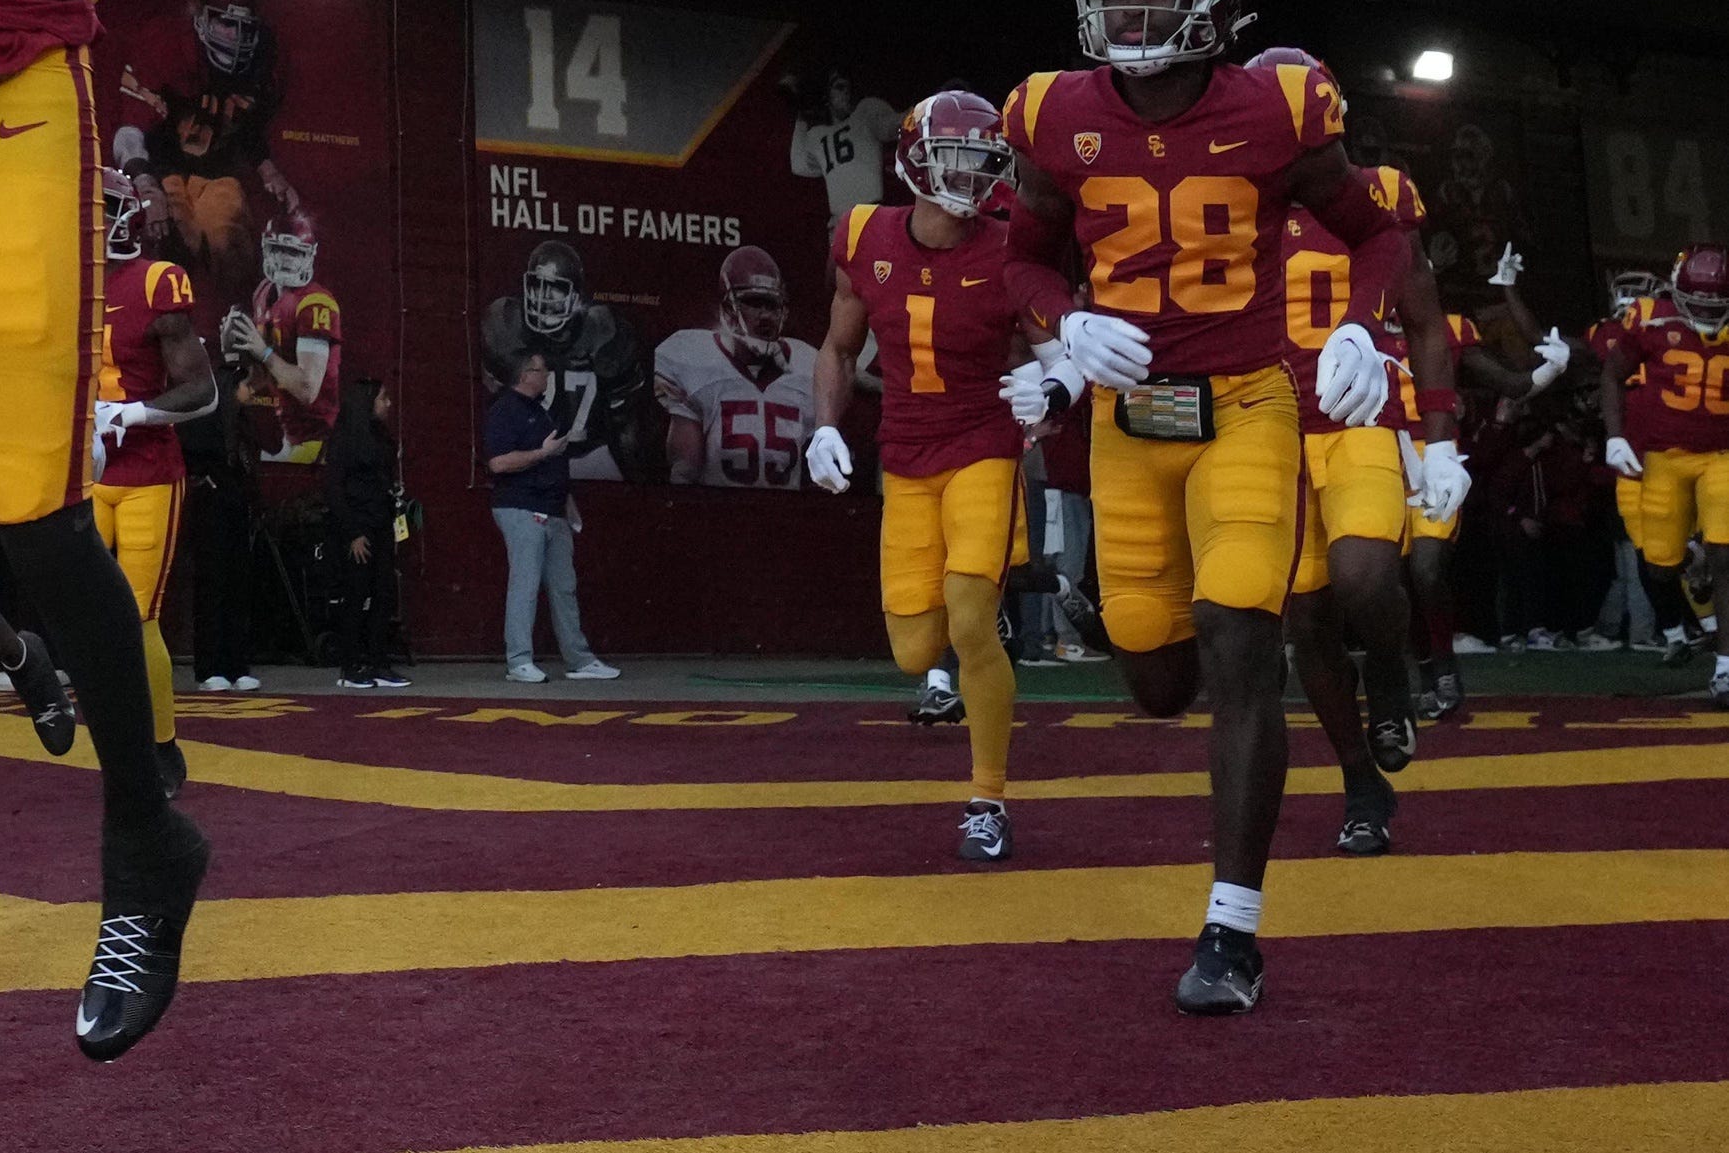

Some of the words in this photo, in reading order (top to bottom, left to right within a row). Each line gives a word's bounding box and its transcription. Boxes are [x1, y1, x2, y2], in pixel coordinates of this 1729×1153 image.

[523, 8, 628, 136] 14
[820, 125, 855, 174] 16
[489, 164, 548, 199] NFL
[489, 197, 569, 234] HALL
[578, 203, 615, 236] OF
[623, 207, 742, 248] FAMERS
[1078, 176, 1259, 314] 28
[167, 273, 194, 304] 14
[311, 307, 331, 330] 14
[905, 294, 945, 394] 1
[720, 399, 802, 486] 55
